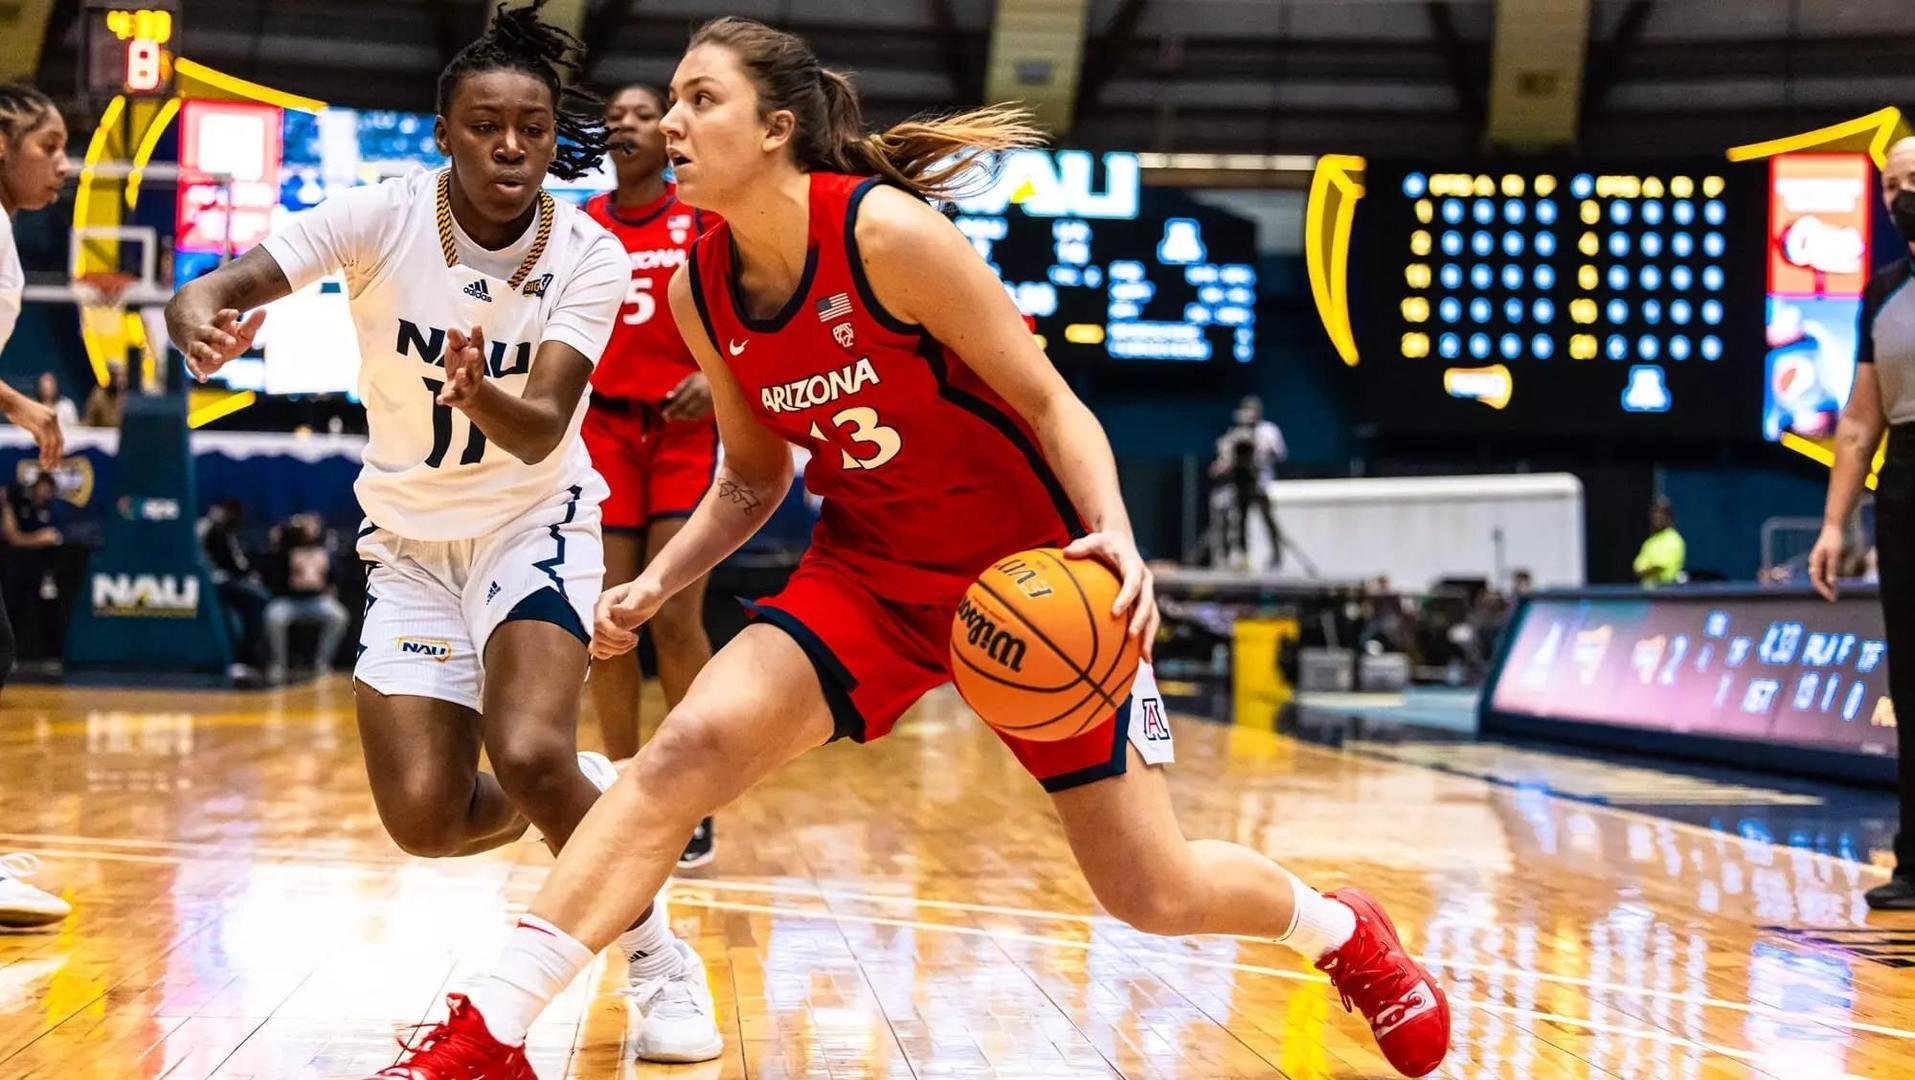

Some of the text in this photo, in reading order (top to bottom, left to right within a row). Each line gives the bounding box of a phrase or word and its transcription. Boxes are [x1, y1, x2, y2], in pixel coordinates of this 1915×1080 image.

[463, 286, 492, 302] adidas
[396, 318, 531, 378] NU
[761, 357, 880, 413] ARIZONA
[93, 573, 199, 608] NAU
[402, 642, 447, 656] NAU
